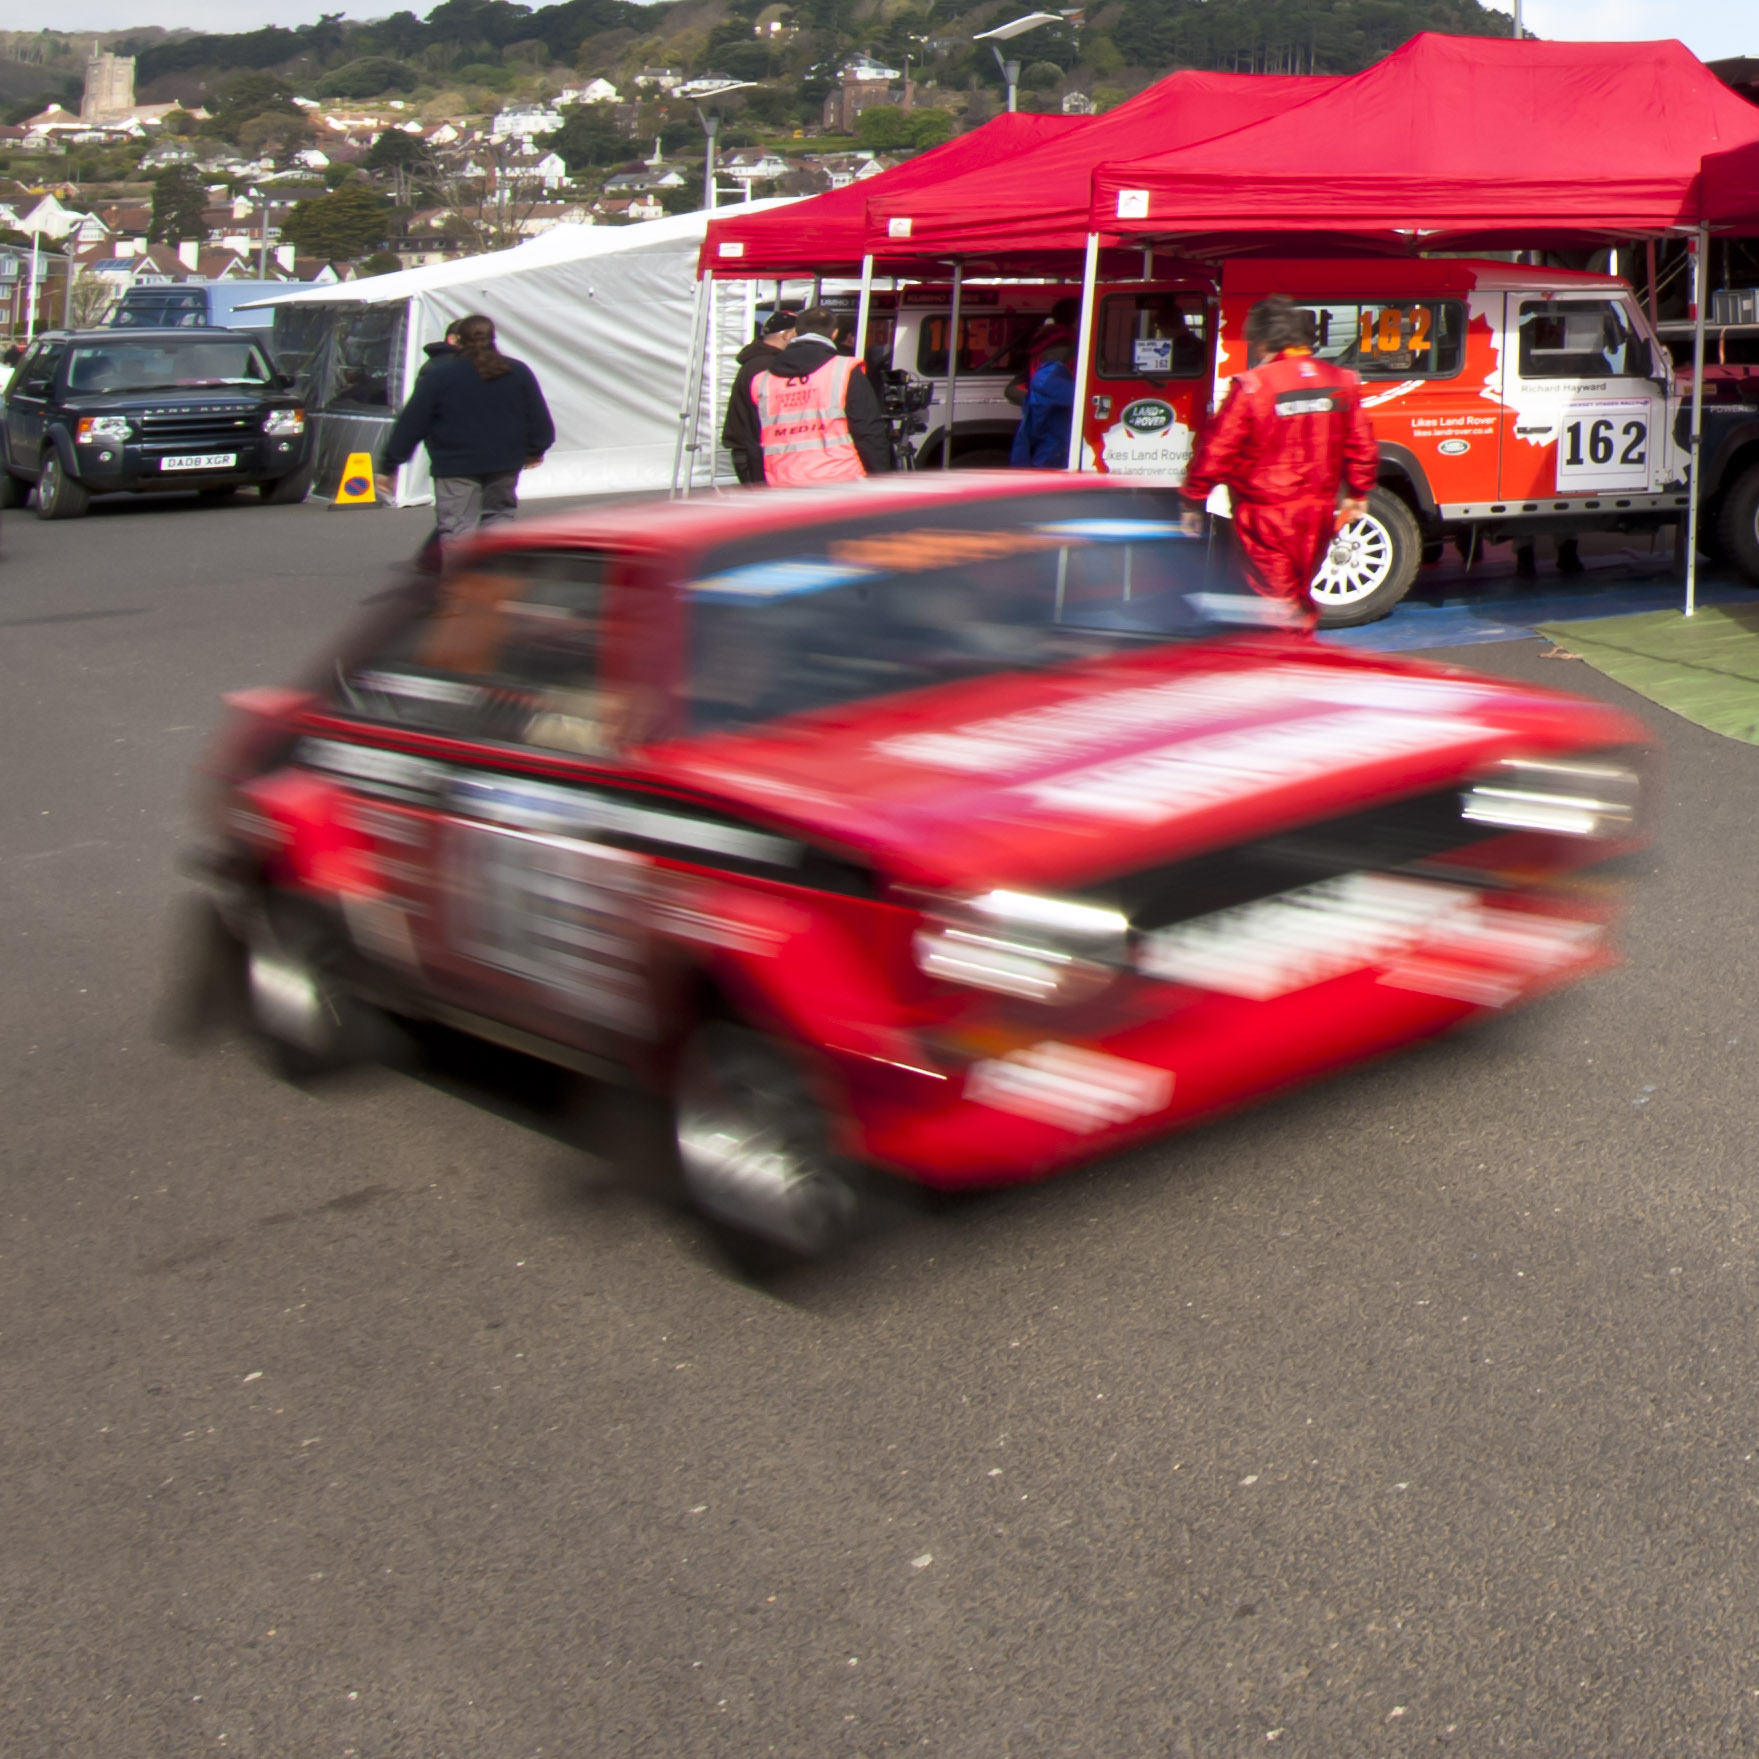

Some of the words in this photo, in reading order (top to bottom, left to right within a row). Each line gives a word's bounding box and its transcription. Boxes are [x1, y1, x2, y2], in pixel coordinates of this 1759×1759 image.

[820, 298, 849, 307] UMHO
[1359, 307, 1432, 353] 162
[1521, 383, 1561, 393] Richard
[1563, 382, 1607, 393] Hayward
[1132, 406, 1159, 416] LAND
[1134, 416, 1167, 427] ROVER
[1411, 417, 1438, 428] Likes
[1440, 416, 1465, 427] Land
[1466, 415, 1497, 426] Rover
[774, 423, 826, 437] MEDIA
[1565, 418, 1648, 466] 162
[206, 455, 230, 466] XGR
[1131, 448, 1158, 461] Land
[1161, 448, 1194, 461] Rover
